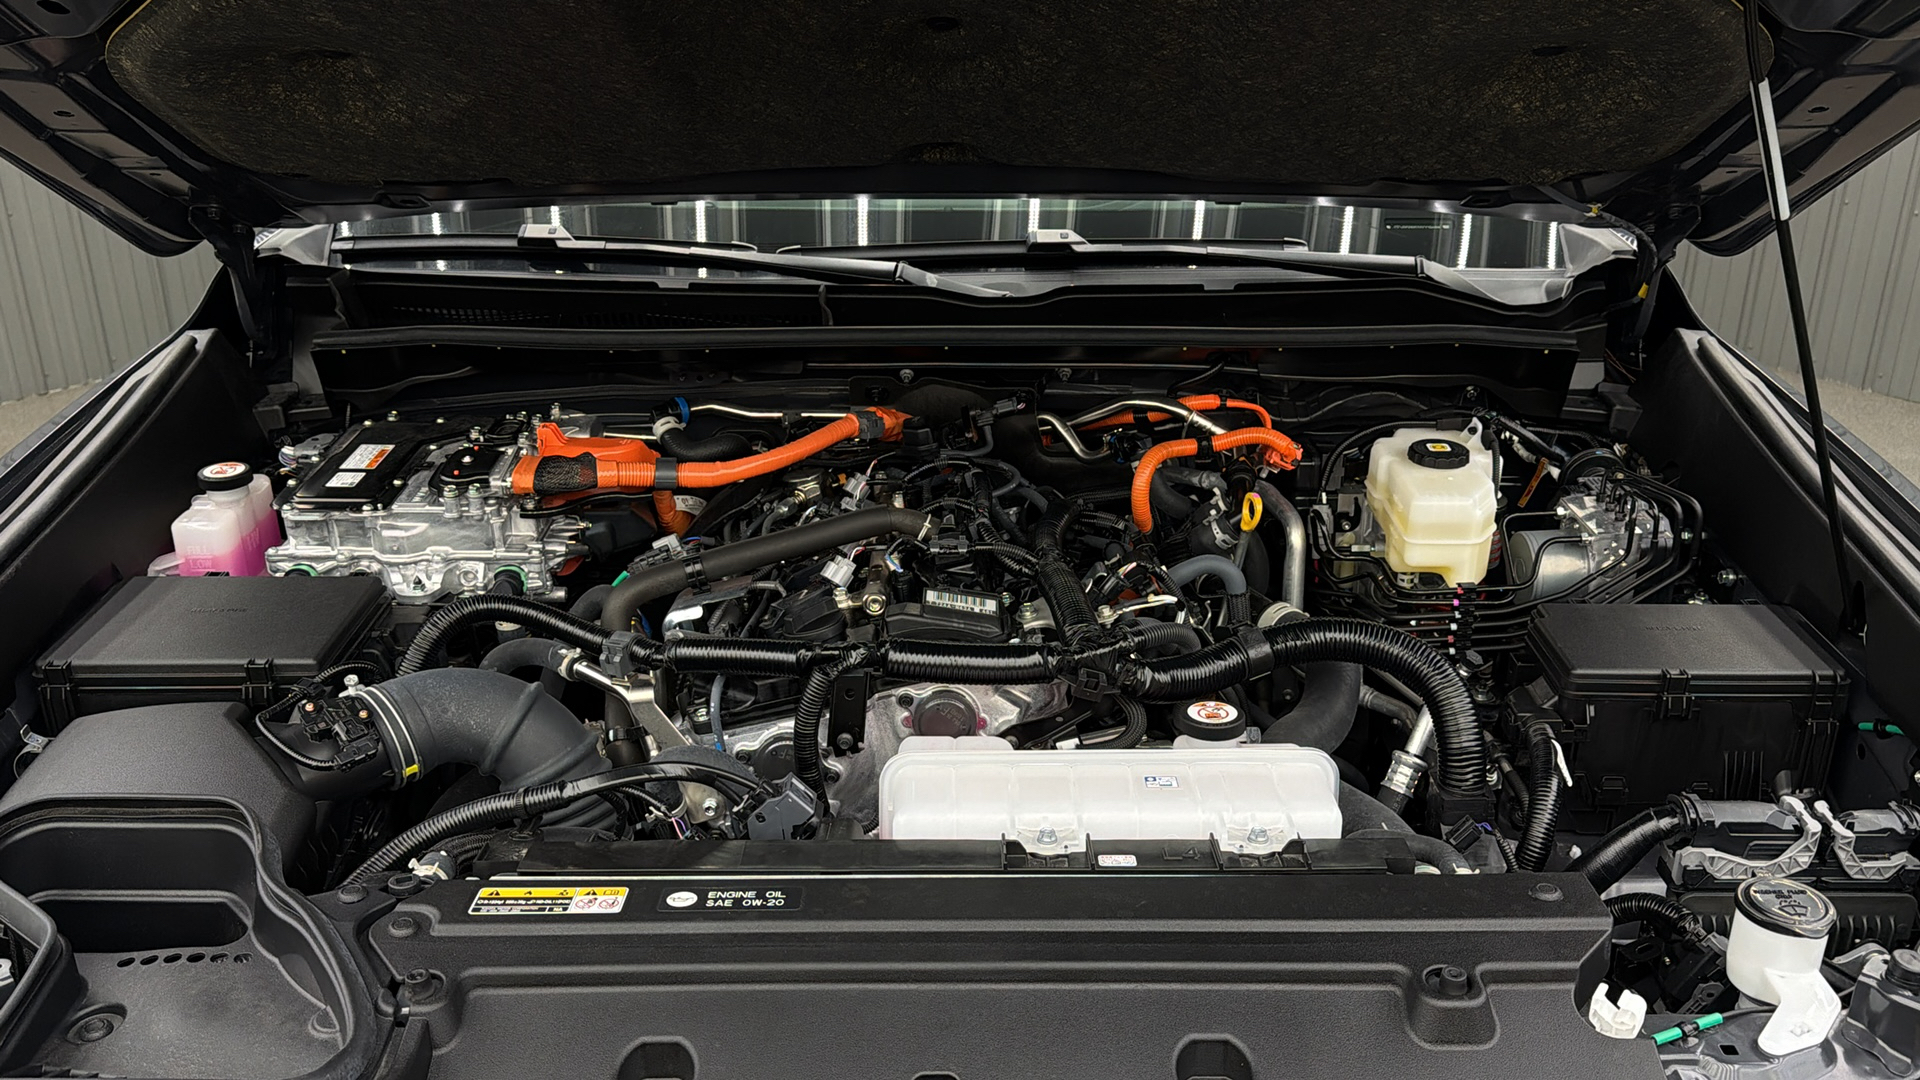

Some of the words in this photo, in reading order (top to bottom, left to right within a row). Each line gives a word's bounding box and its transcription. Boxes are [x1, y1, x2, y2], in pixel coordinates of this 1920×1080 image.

[189, 560, 212, 569] LOW
[705, 899, 734, 907] SAE
[742, 899, 785, 907] 0W-20
